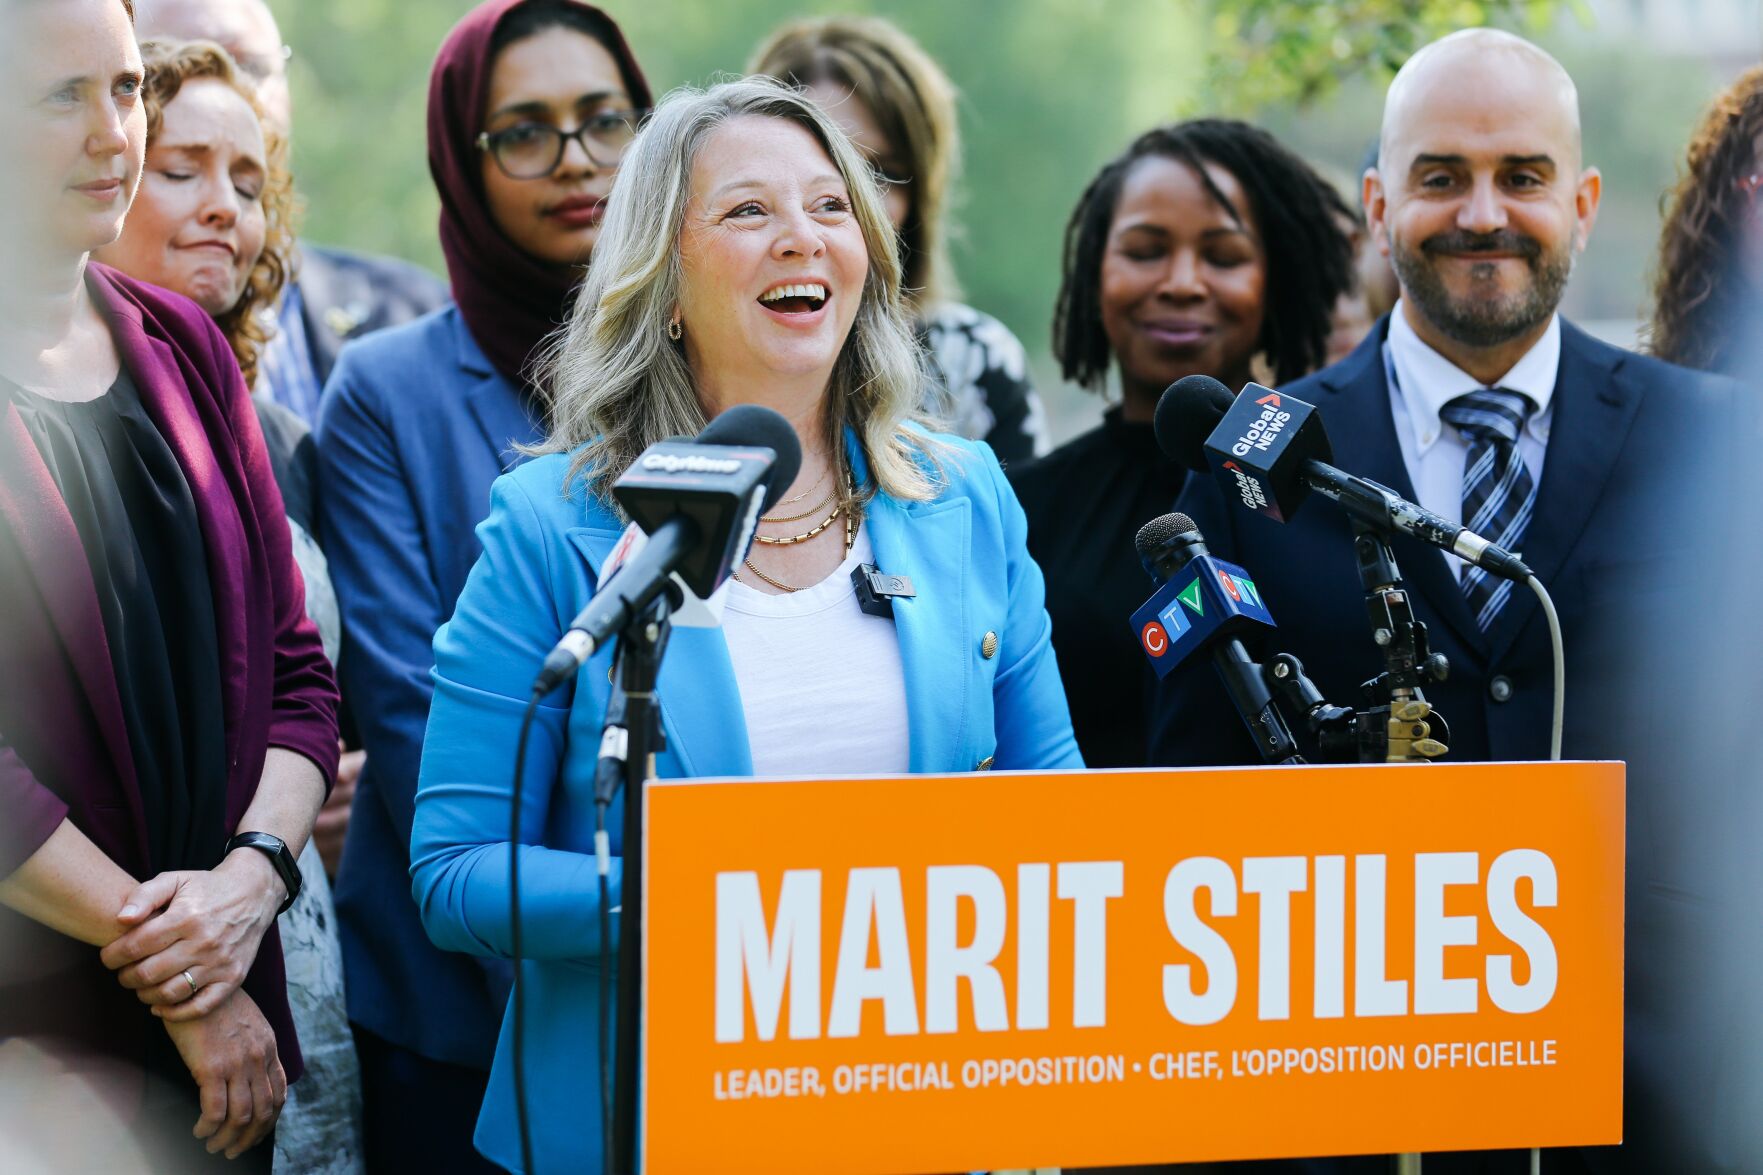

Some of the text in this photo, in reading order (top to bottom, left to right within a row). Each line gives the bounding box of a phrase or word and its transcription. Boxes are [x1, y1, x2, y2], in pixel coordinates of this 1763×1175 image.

[1232, 404, 1279, 456] Global
[1254, 411, 1291, 451] NEWS
[1231, 468, 1258, 509] Global
[1246, 476, 1268, 507] NEWS
[1222, 573, 1264, 609] CTV
[1145, 582, 1202, 653] CTV
[714, 848, 1559, 1044] MARIT STILES
[714, 1066, 826, 1100] LEADER,
[832, 1061, 954, 1094] OFFICIAL
[961, 1054, 1125, 1090] OPPOSITION
[1148, 1051, 1223, 1081] CHEF,
[1231, 1044, 1405, 1077] L'OPPOSITION
[1413, 1039, 1557, 1070] OFFICIELLE
